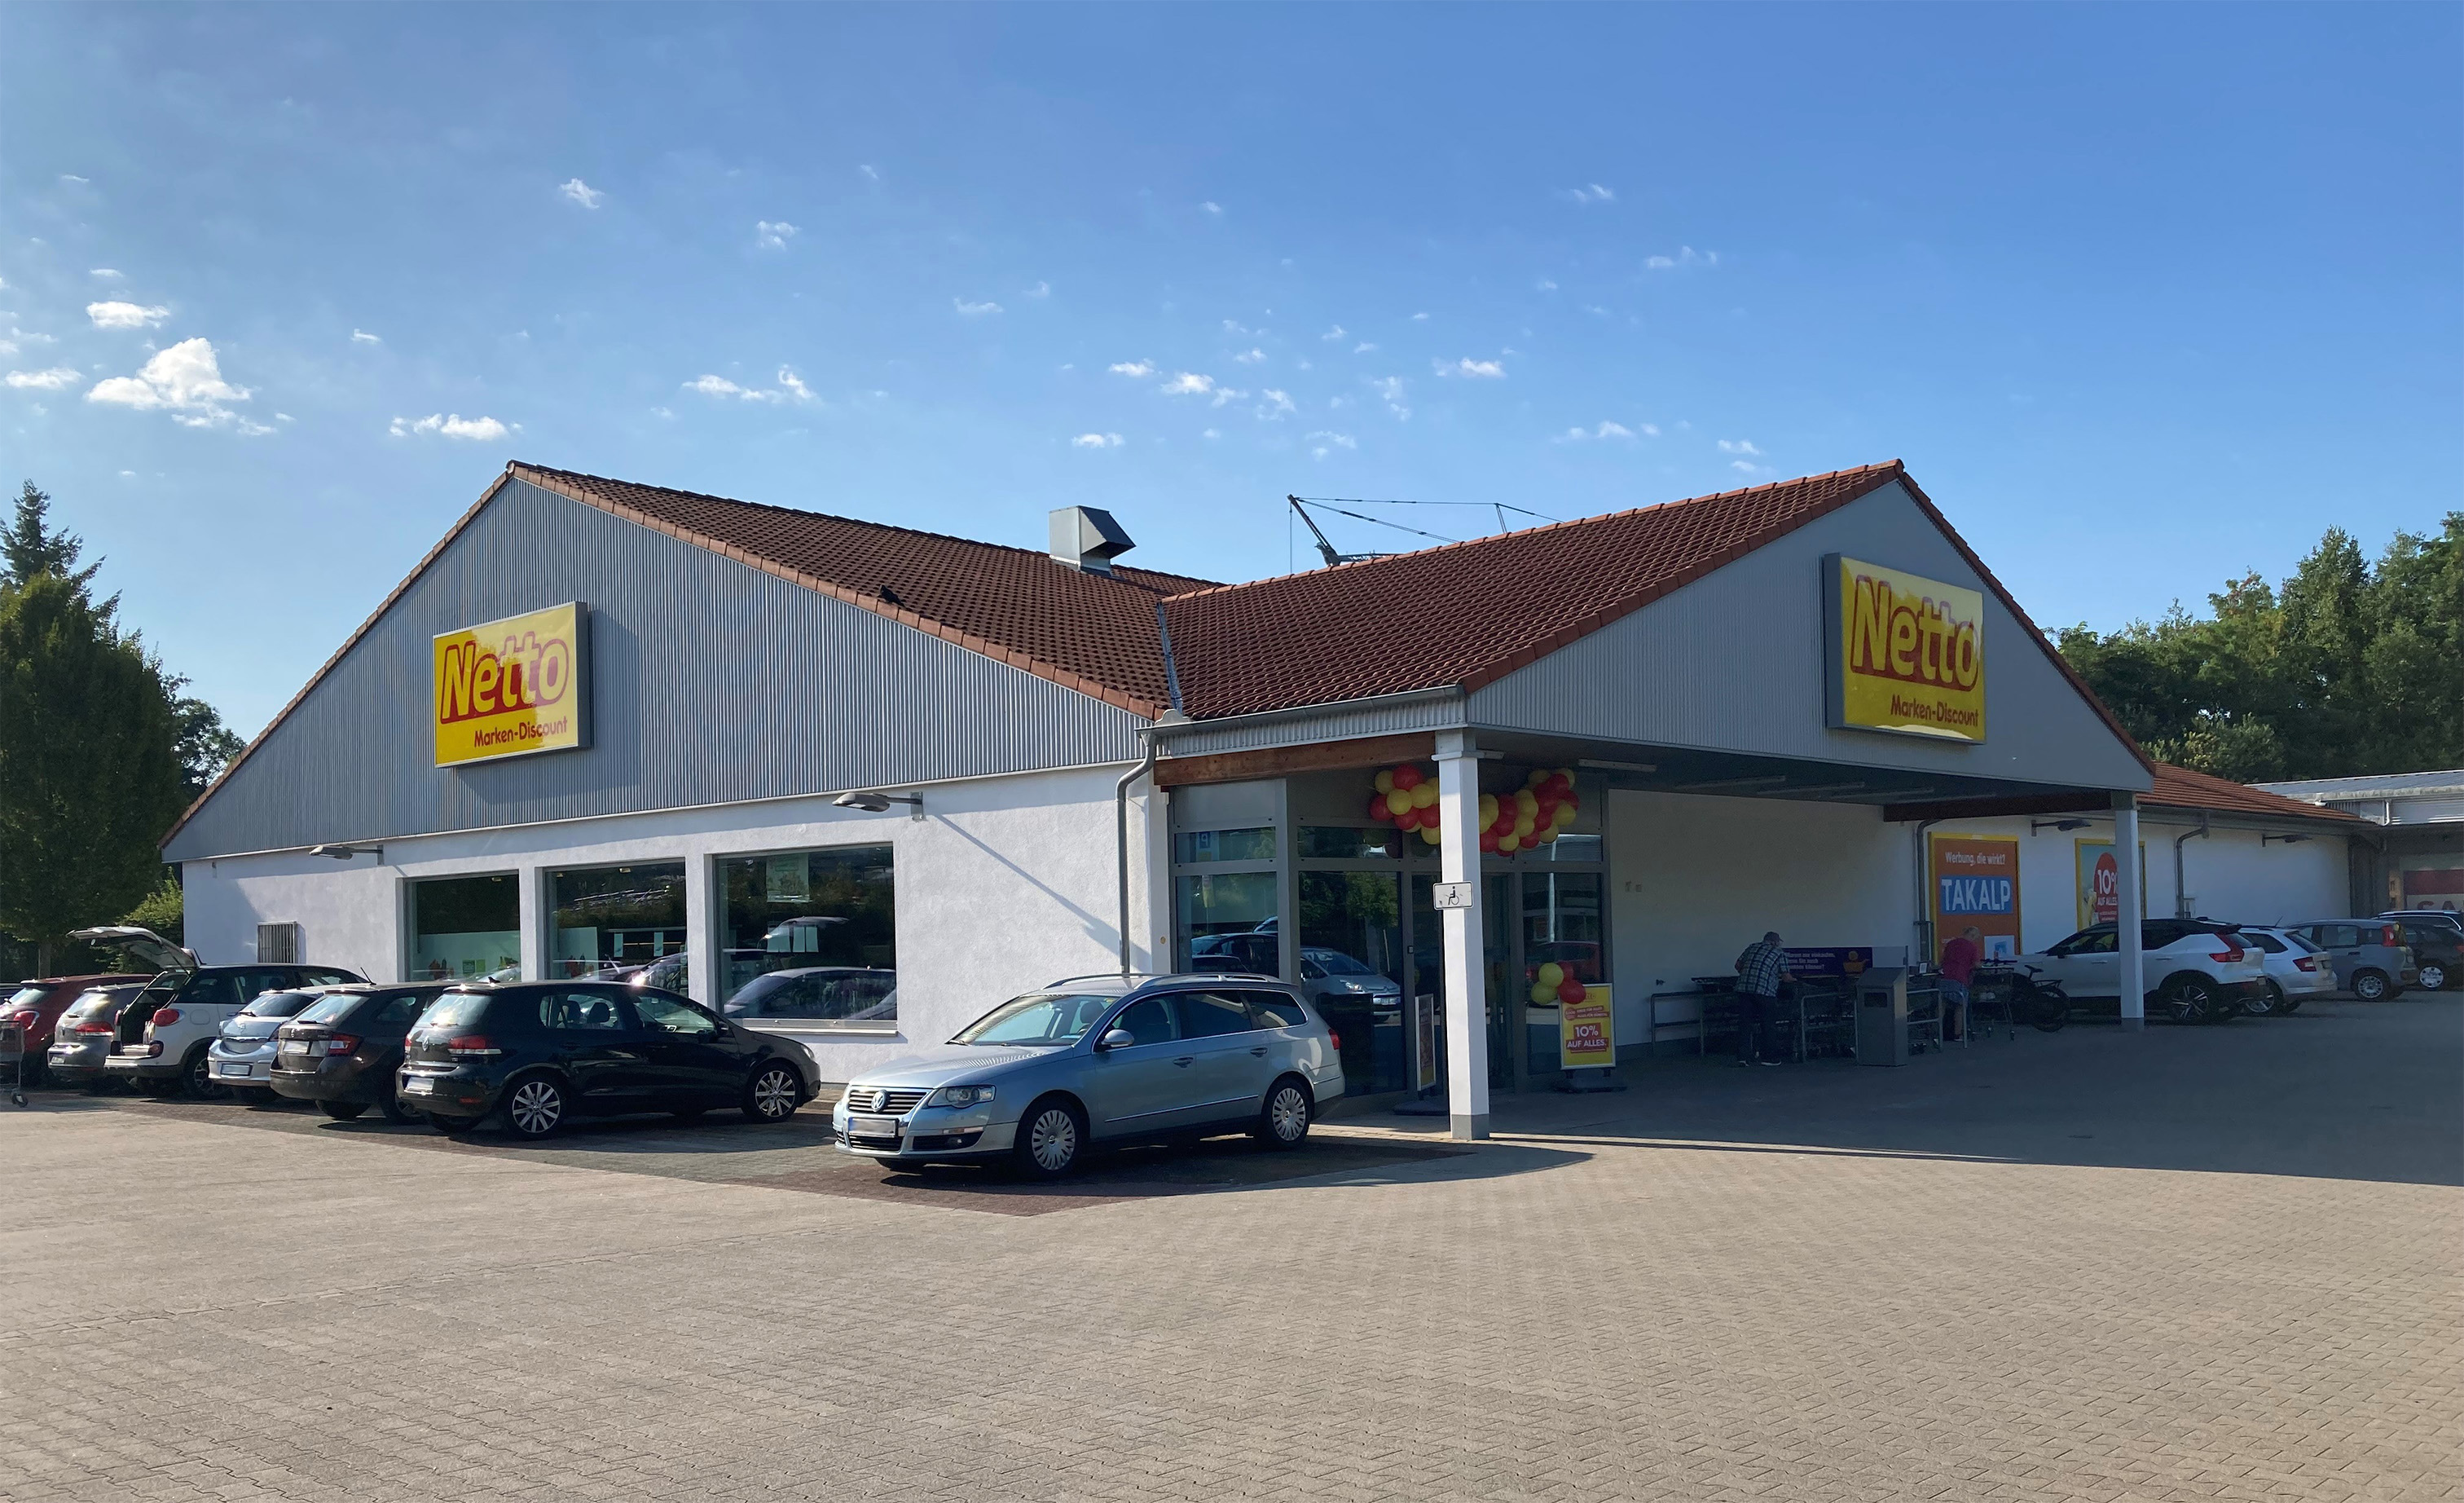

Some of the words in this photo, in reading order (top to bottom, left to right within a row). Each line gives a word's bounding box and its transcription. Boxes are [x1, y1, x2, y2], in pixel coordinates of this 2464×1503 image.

[1850, 575, 1979, 692] Netto
[440, 631, 570, 725] Netto
[1890, 694, 1979, 727] Marken-Discount
[473, 716, 568, 748] Marken-Discount
[1945, 852, 1975, 867] Werbung,
[1977, 853, 1987, 865] die
[1987, 853, 2006, 866] wirkt?
[1941, 879, 2012, 911] TAKALP
[1567, 1040, 1582, 1048] AUF
[1575, 1025, 1599, 1038] 10%
